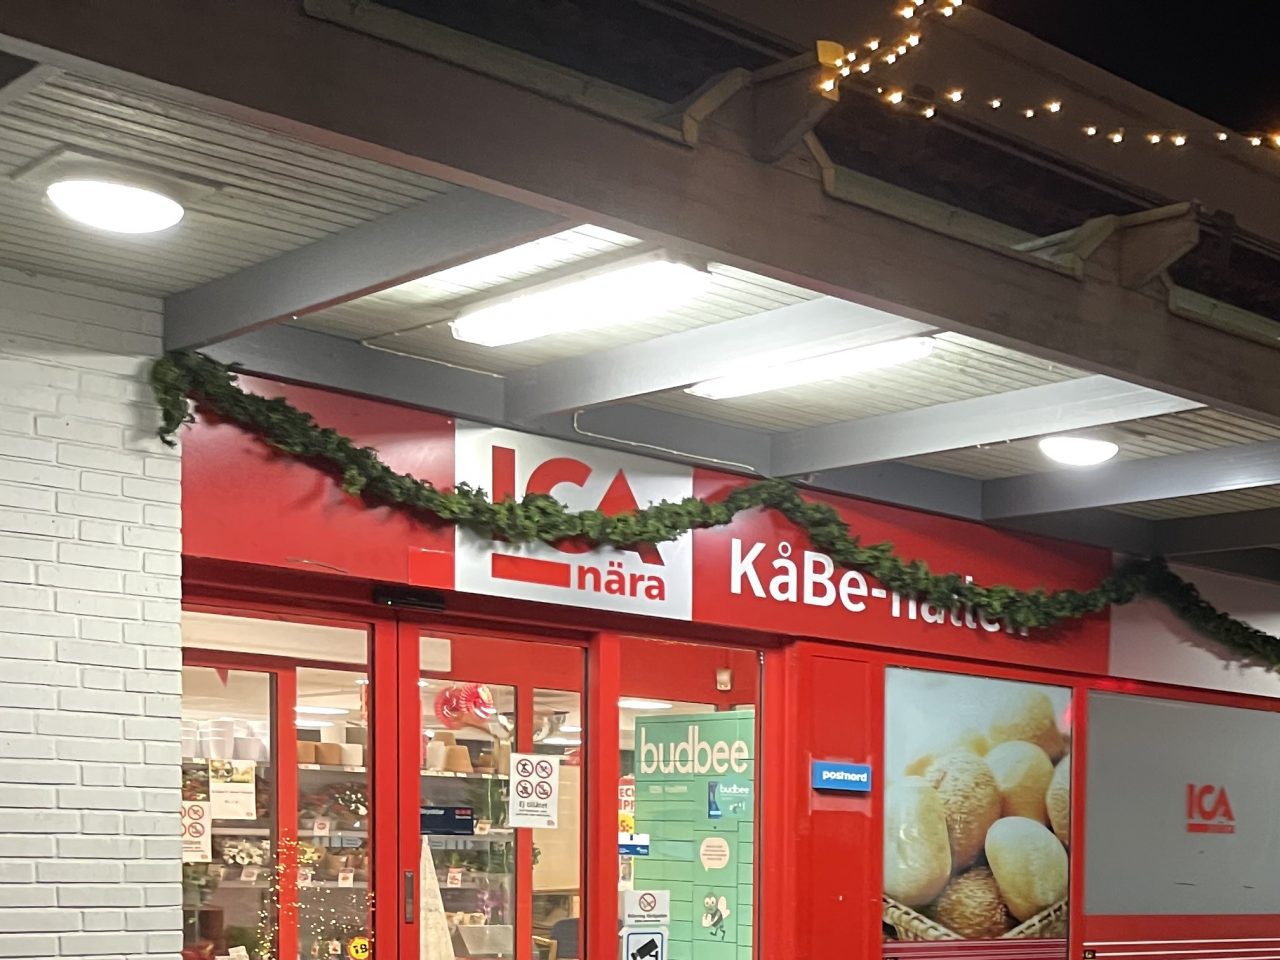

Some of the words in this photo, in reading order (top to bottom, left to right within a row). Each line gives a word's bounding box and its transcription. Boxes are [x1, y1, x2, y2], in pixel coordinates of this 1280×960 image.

[491, 444, 666, 567] ICA
[576, 560, 666, 602] nära
[640, 725, 749, 774] budbee
[719, 783, 750, 795] budbee
[822, 770, 868, 782] postnord
[1187, 784, 1235, 821] ICA
